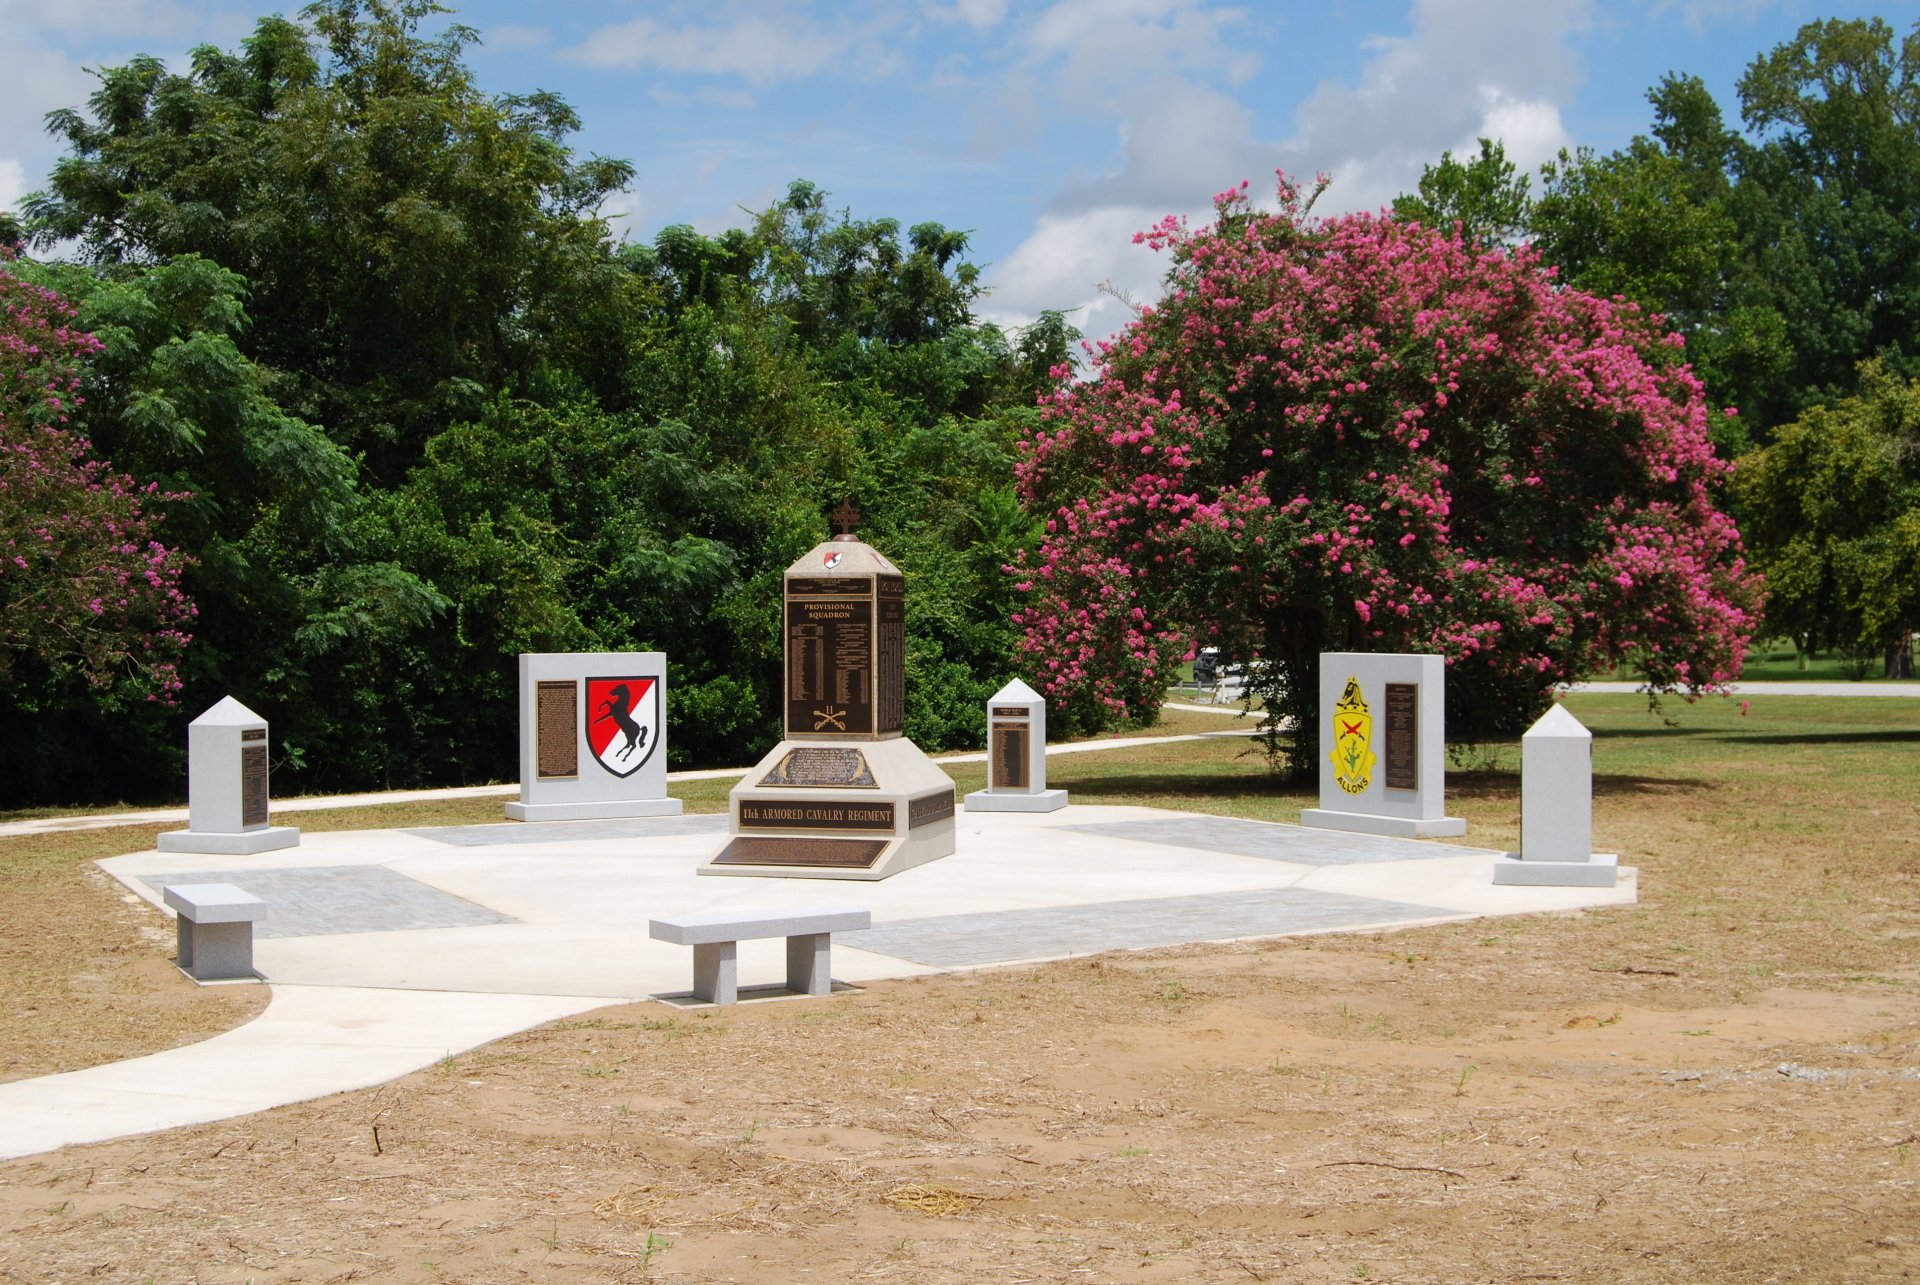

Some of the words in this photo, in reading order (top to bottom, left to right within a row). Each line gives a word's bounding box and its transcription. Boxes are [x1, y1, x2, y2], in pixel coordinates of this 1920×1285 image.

[804, 603, 855, 611] PROVISIONAL
[825, 705, 833, 714] 11
[1337, 777, 1368, 793] ALLONS
[743, 808, 759, 819] 11th
[763, 808, 803, 820] ARMORED
[806, 809, 844, 821] CAVALRY
[848, 810, 892, 822] REGIMENT
